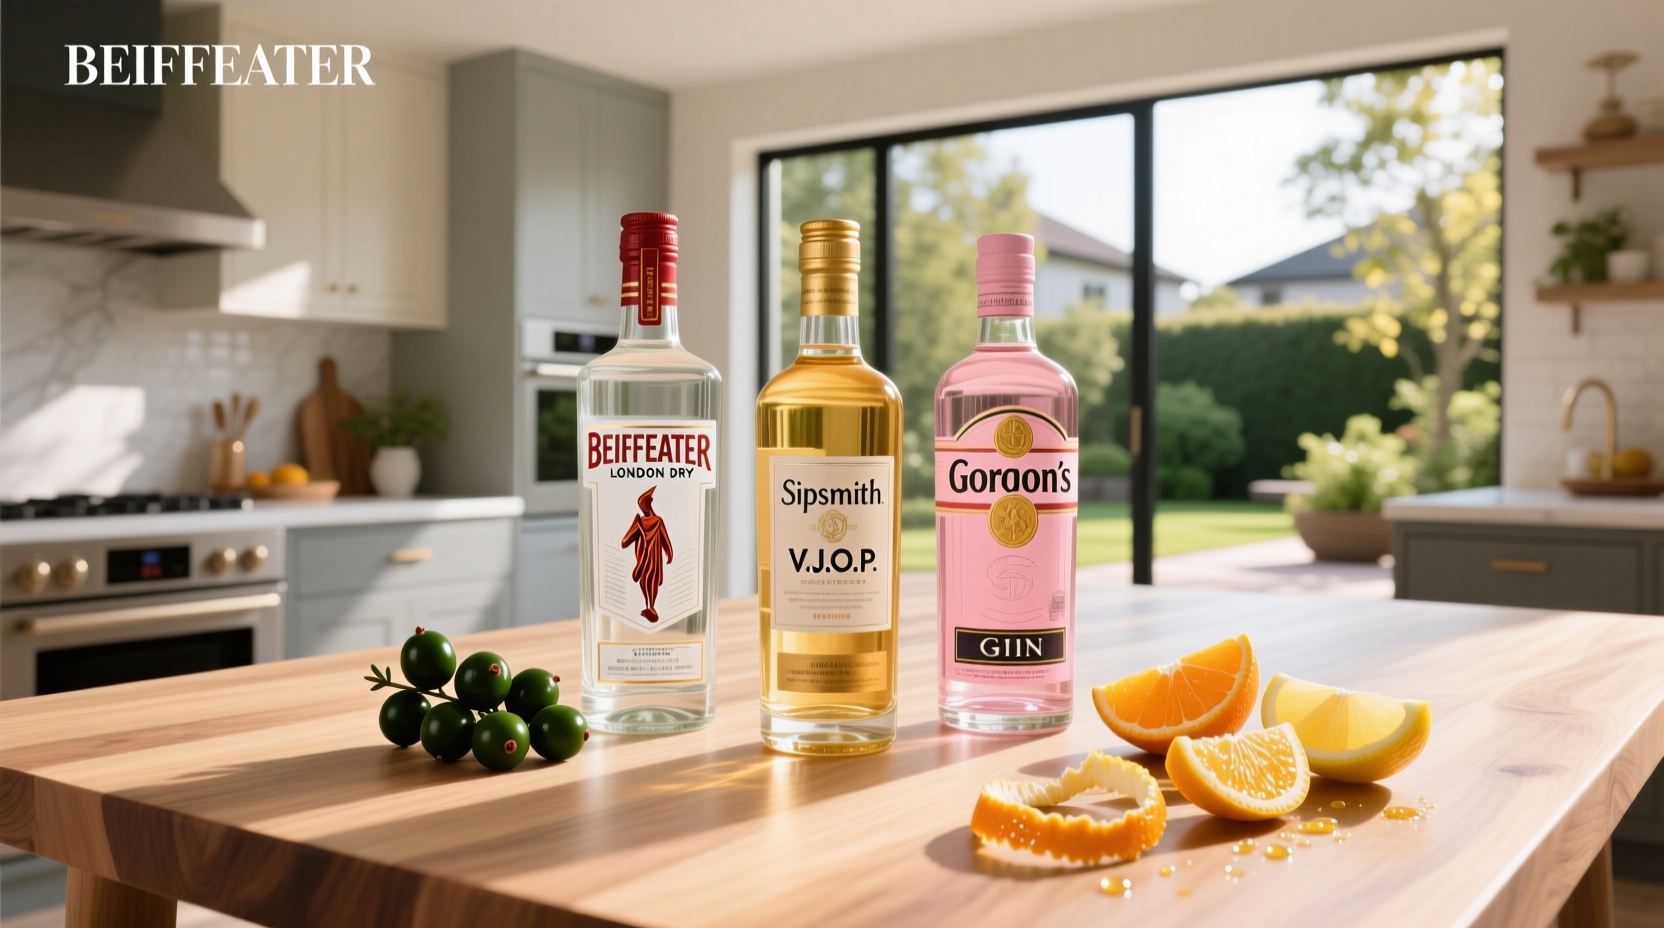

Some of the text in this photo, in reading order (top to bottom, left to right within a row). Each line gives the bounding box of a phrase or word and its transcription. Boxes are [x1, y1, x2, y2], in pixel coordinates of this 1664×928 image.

[588, 432, 712, 471] BEIFFEATER
[610, 467, 694, 479] LONDON DRY
[788, 548, 877, 573] V.J.O.P.
[980, 637, 1042, 657] GIIN
